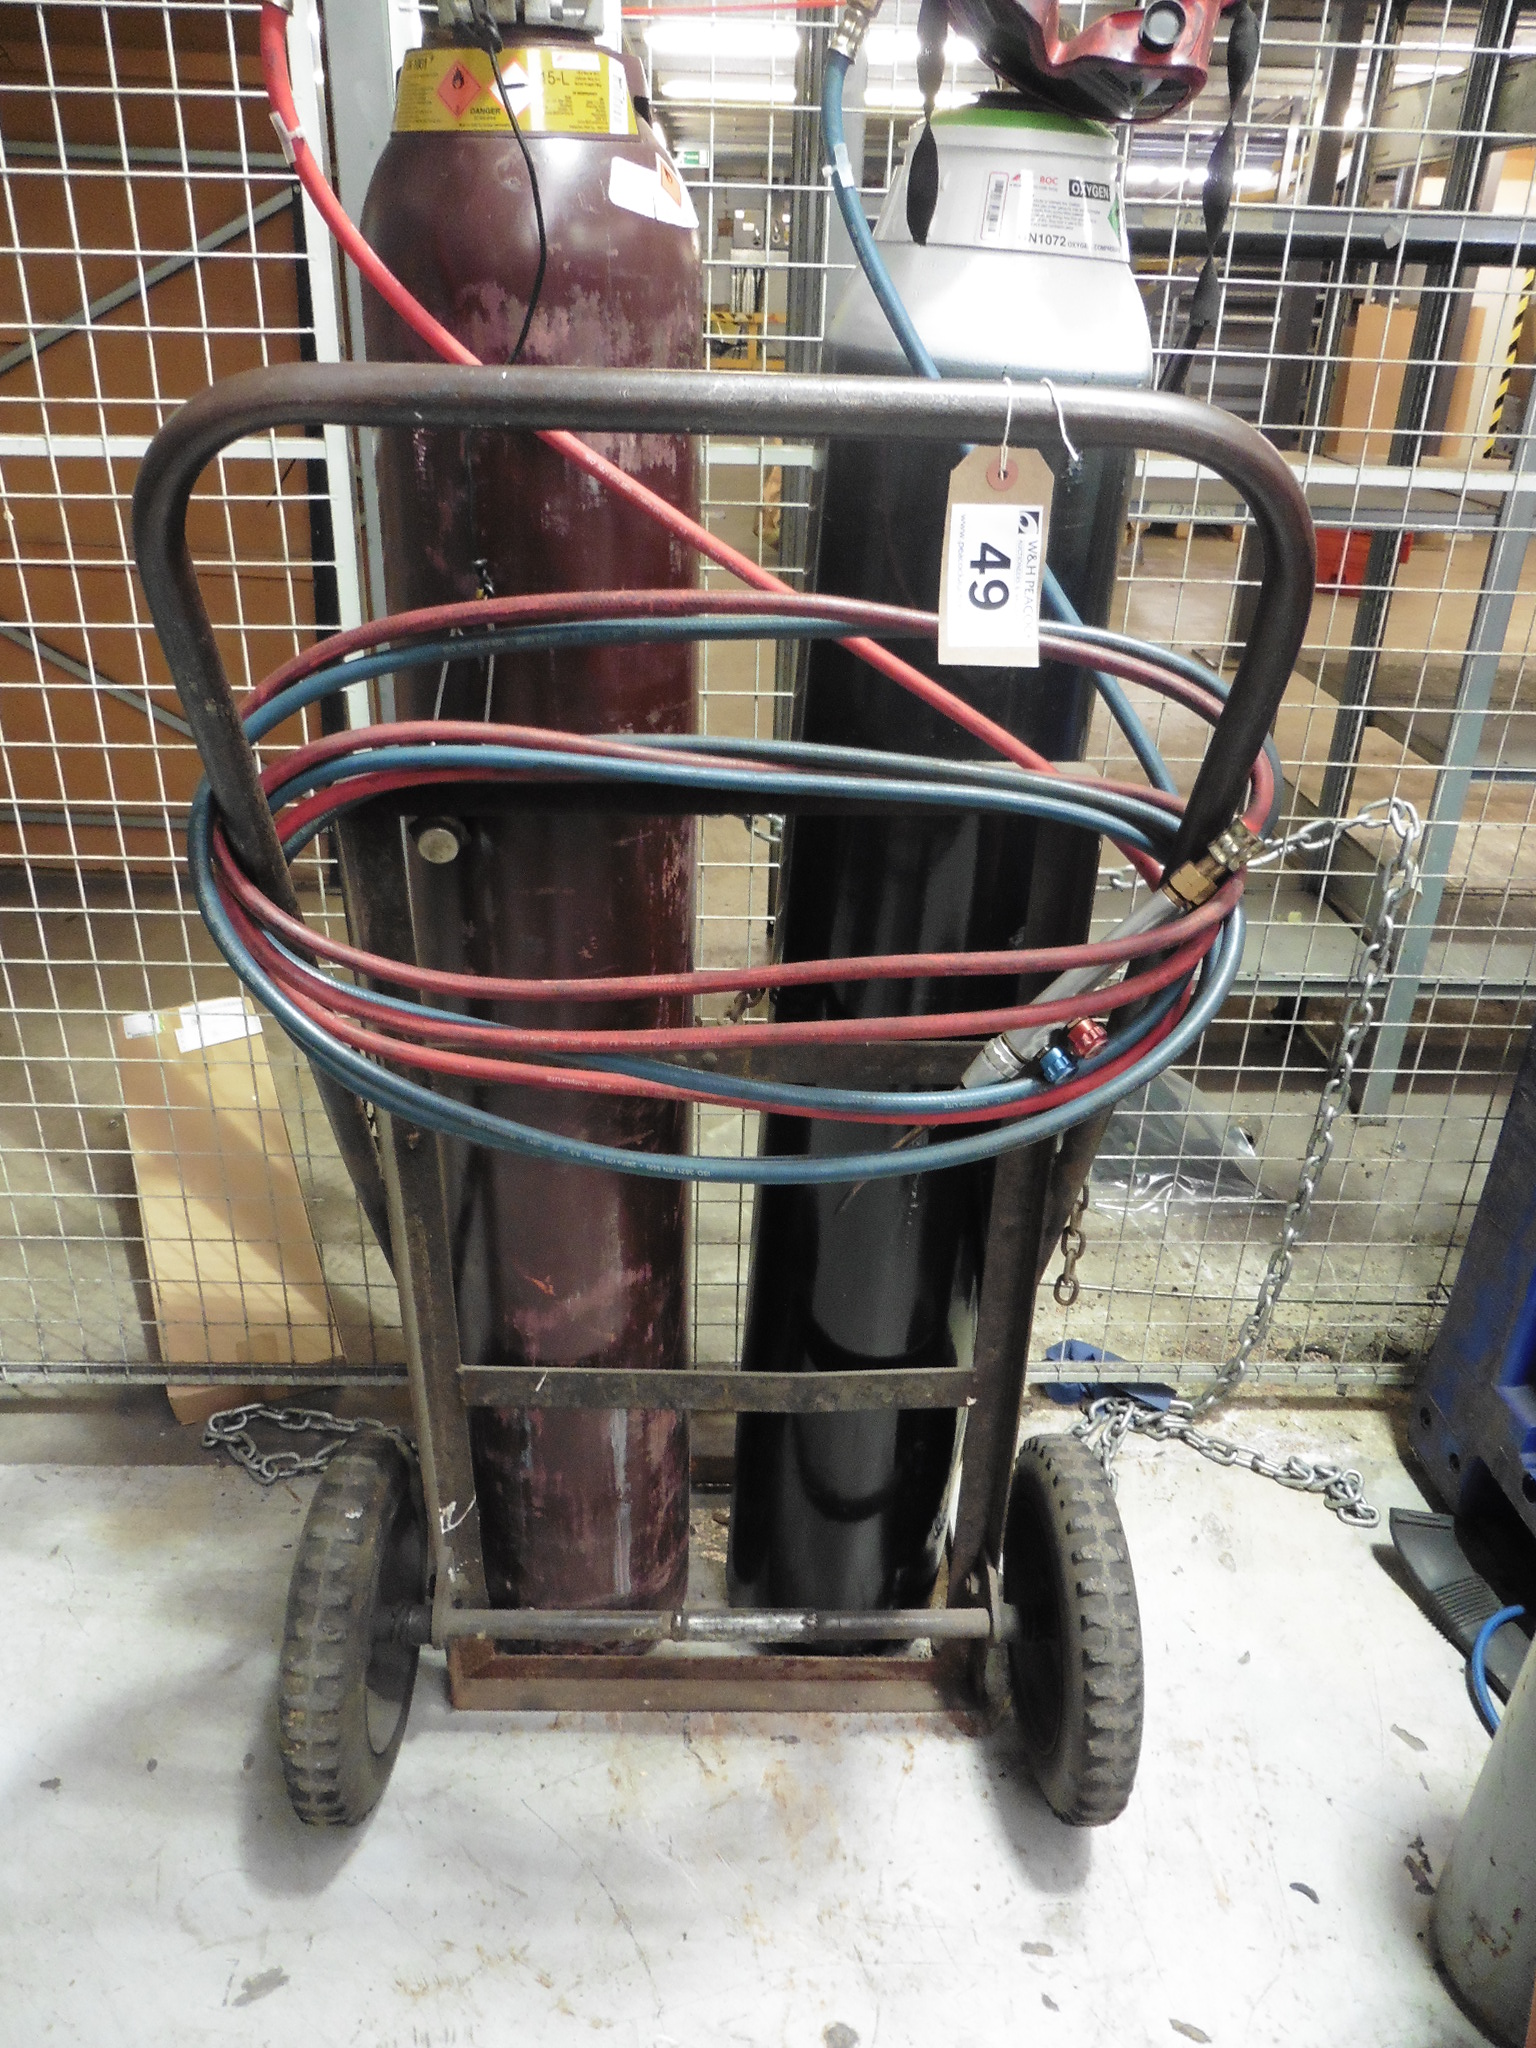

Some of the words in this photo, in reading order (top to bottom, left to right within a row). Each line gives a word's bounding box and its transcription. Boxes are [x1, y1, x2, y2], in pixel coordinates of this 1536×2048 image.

[470, 107, 501, 115] DANGER
[1071, 182, 1109, 200] OXYGEN
[1019, 232, 1067, 247] N1072
[1025, 539, 1039, 576] W&H
[968, 541, 1012, 611] 49
[1022, 580, 1035, 639] PEACOC
